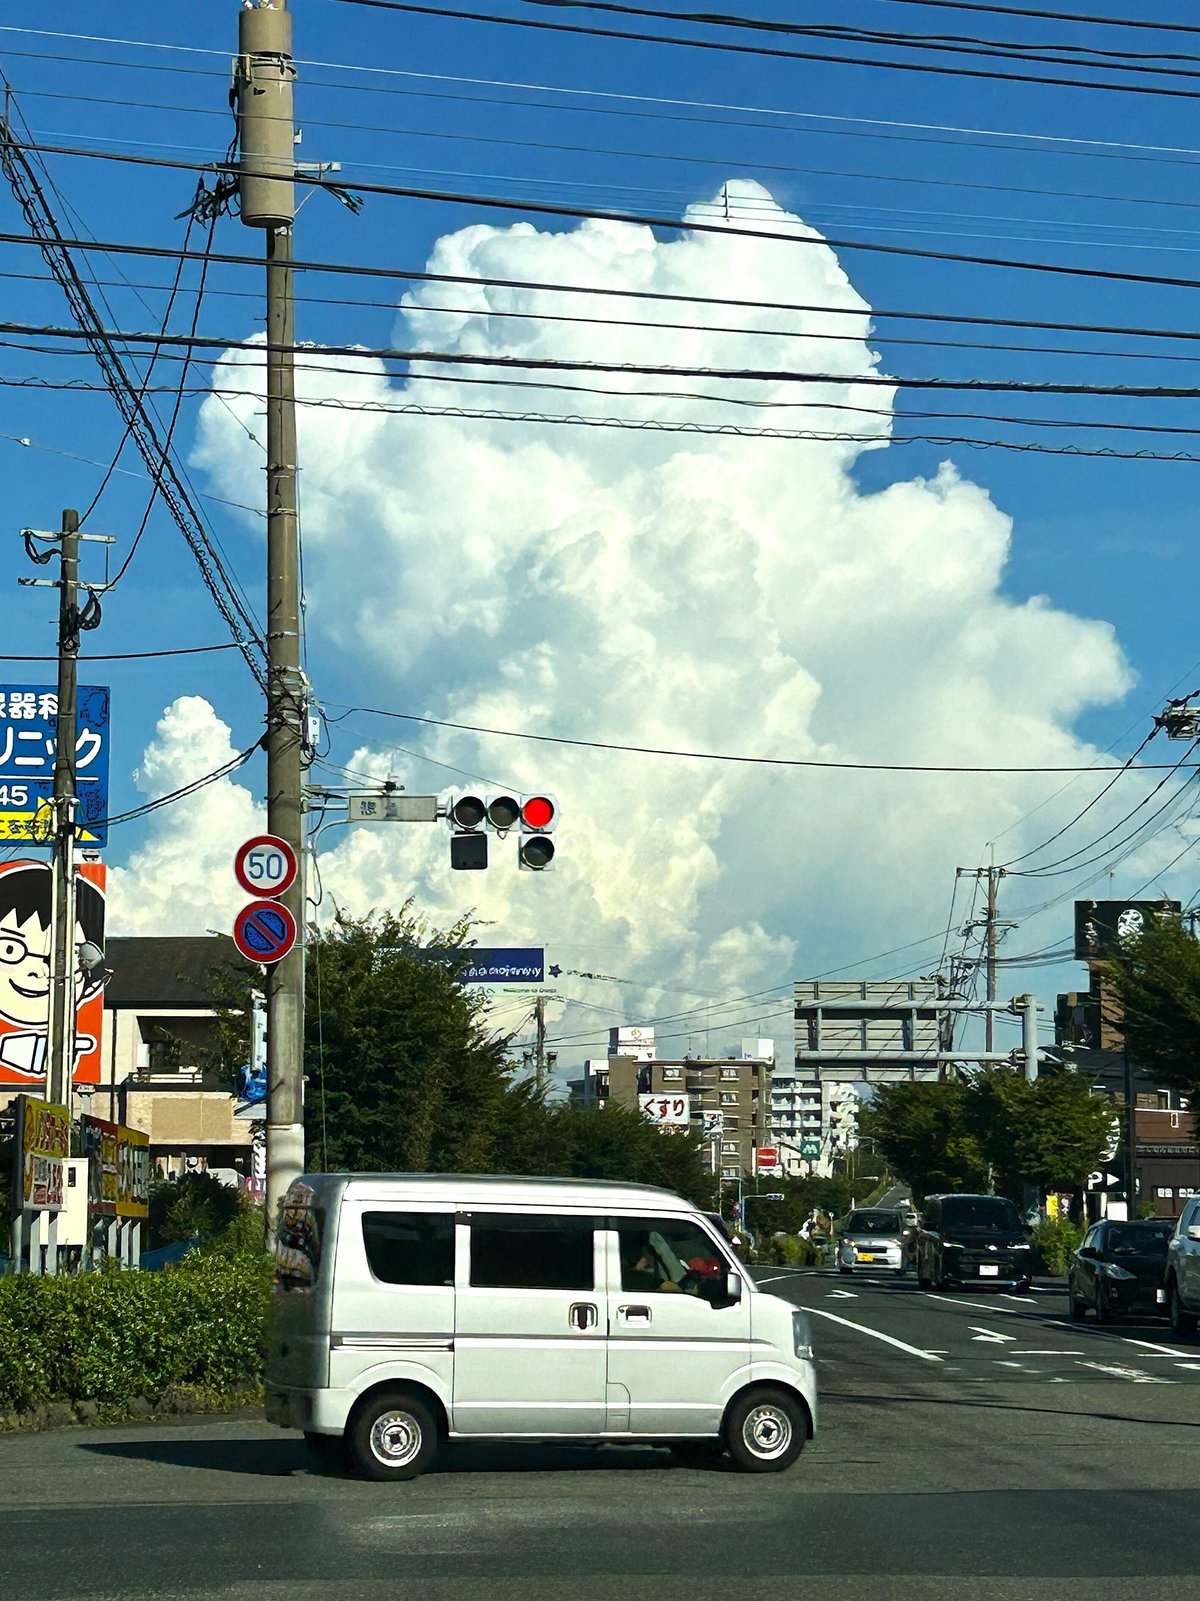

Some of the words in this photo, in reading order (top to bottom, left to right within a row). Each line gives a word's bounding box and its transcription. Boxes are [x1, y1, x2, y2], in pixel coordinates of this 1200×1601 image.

[0, 692, 58, 720] 器科
[248, 852, 282, 880] 50
[643, 1098, 685, 1118] くすり
[1087, 1171, 1103, 1190] P
